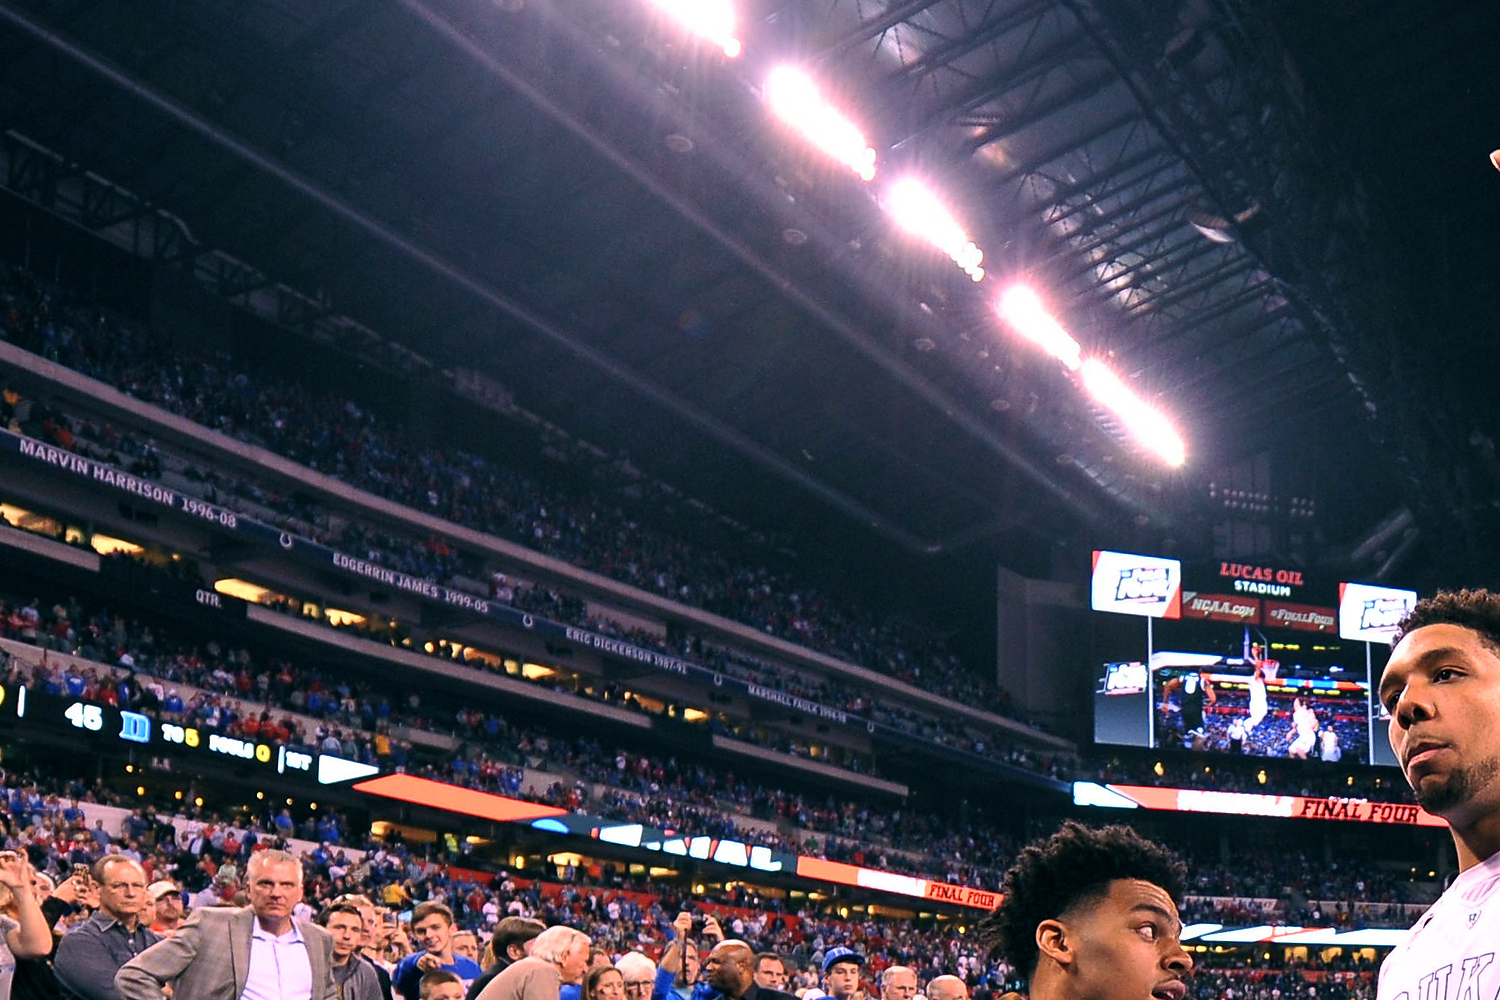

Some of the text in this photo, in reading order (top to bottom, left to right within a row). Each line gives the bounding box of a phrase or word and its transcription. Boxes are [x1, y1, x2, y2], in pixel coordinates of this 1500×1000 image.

[19, 439, 236, 529] MARVIN HARRISON 1996-08
[333, 552, 489, 613] EDGERRIN JAMES 1999-05
[1220, 562, 1303, 586] LUCAS OIL
[1234, 579, 1291, 597] STADIUM
[566, 627, 590, 645] ERIC
[593, 637, 651, 663] DICKERSON
[1300, 801, 1361, 818] FINAL
[1368, 804, 1419, 823] FOUR
[929, 884, 996, 908] FINAL FOUR
